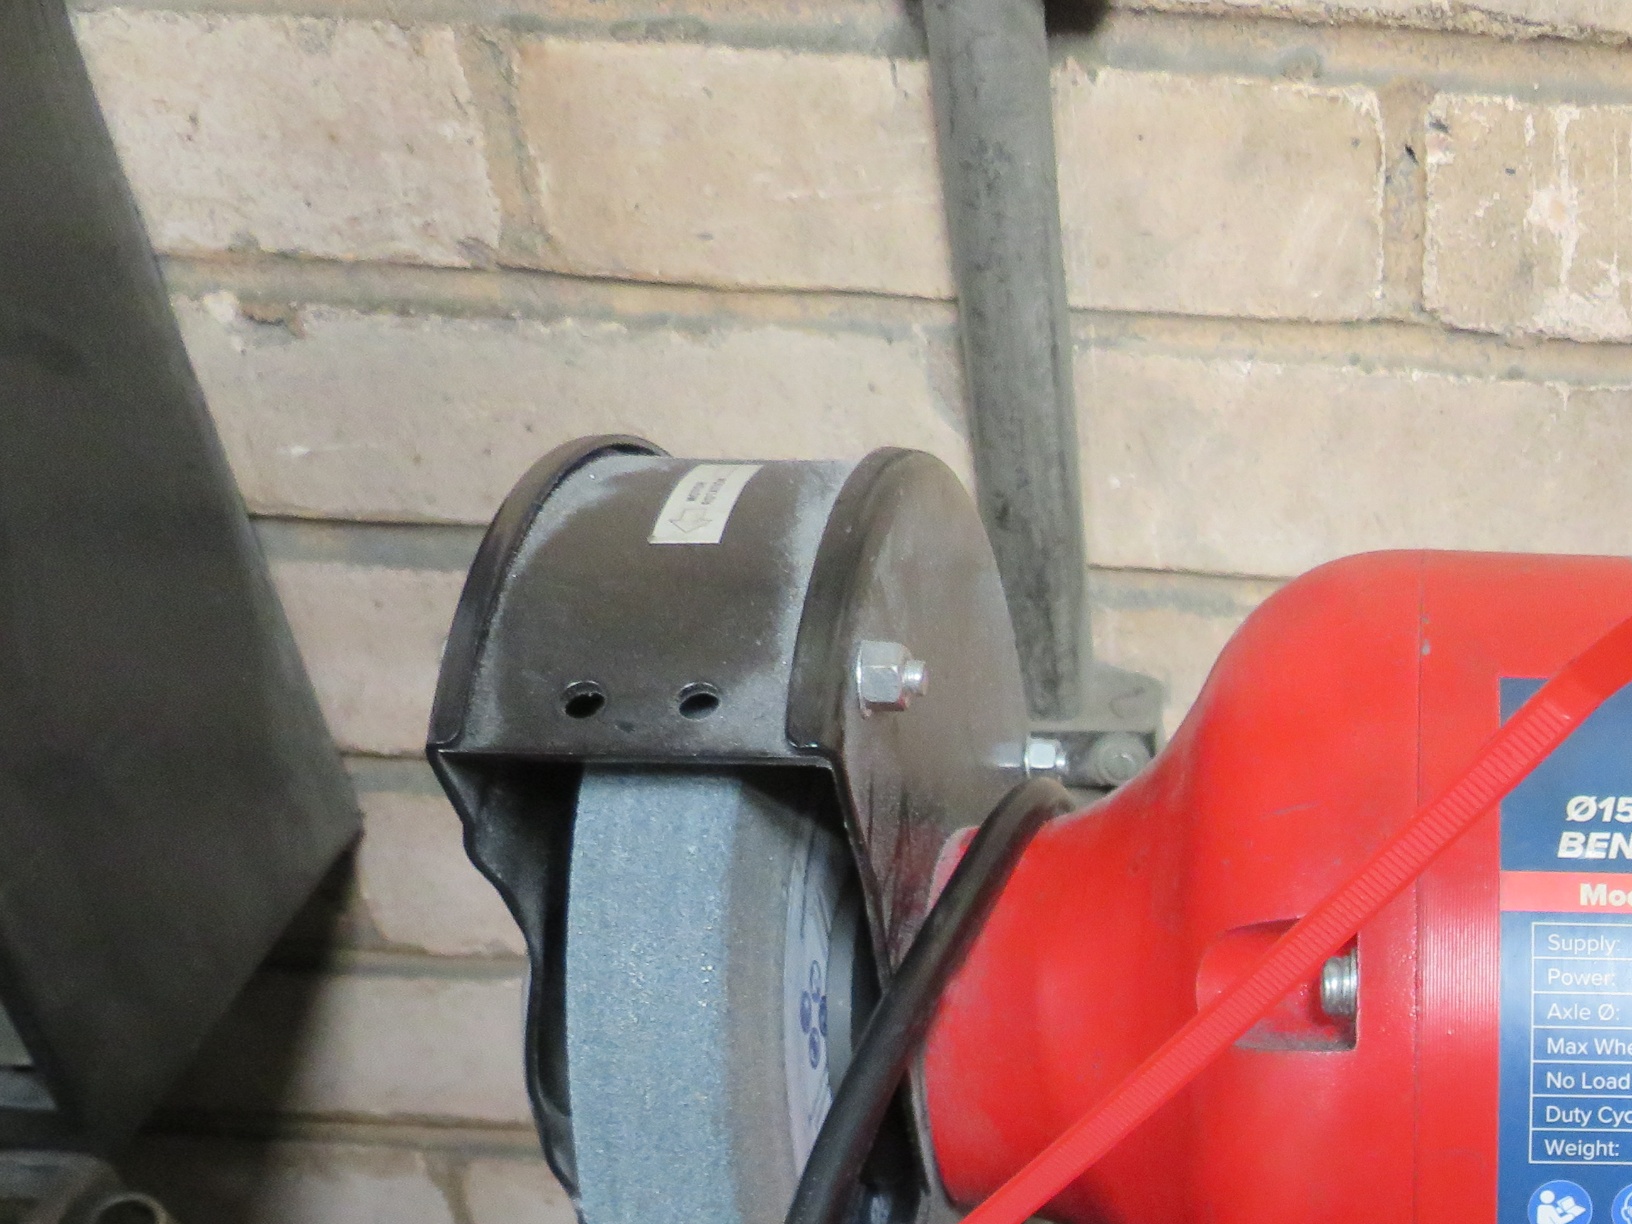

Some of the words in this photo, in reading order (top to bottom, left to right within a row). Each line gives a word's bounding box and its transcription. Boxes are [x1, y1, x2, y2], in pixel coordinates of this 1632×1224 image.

[1548, 934, 1621, 955] Supply:
[1547, 967, 1616, 987] Power:
[1546, 1003, 1592, 1021] Axle
[1547, 1037, 1589, 1055] Max
[1545, 1071, 1576, 1090] No
[1581, 1072, 1631, 1090] Load
[1544, 1105, 1592, 1127] Duty
[1543, 1138, 1621, 1161] Weight:
